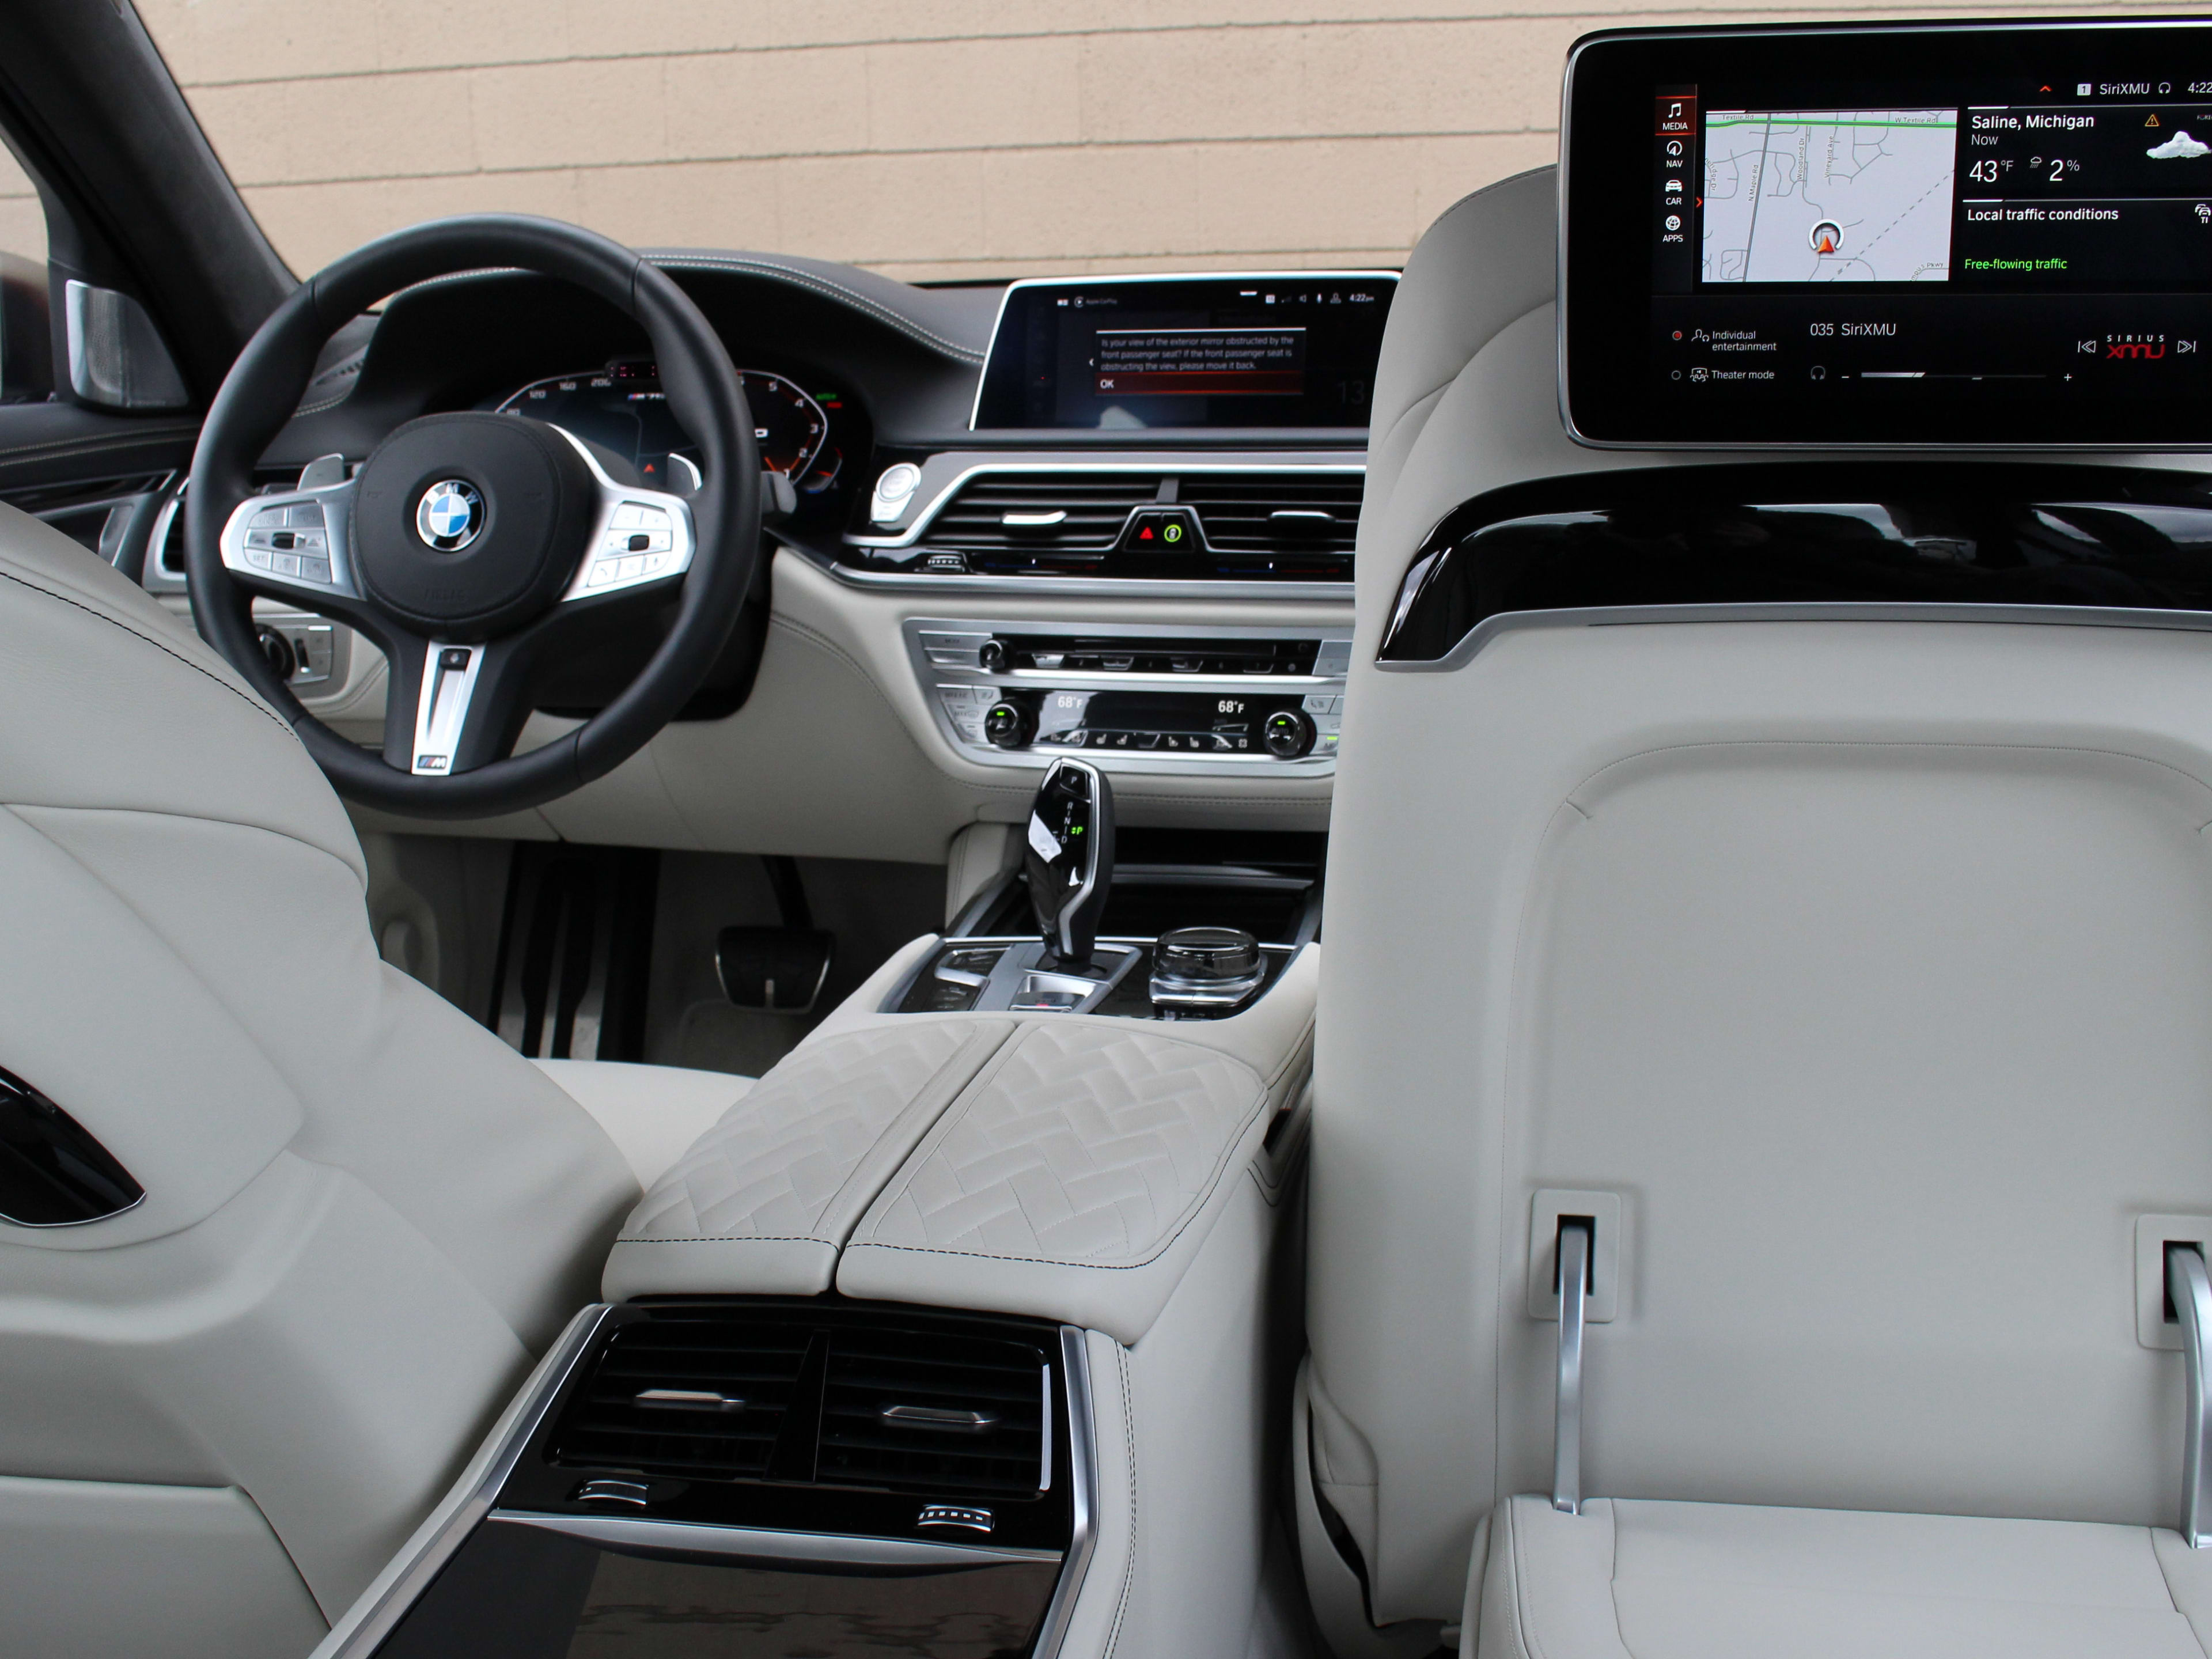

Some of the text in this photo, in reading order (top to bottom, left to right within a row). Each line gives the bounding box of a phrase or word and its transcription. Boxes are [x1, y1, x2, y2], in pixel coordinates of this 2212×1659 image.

[2099, 83, 2150, 95] SiriXMU
[1662, 122, 1688, 131] MEDIA
[1971, 115, 2094, 130] Saline, Michigan
[1798, 137, 1805, 146] Dr
[1971, 134, 1998, 145] Now
[1666, 160, 1683, 168] NAV
[1752, 164, 1759, 174] Rd
[1824, 150, 1832, 178] Vineyard
[1665, 197, 1682, 206] CAR
[1968, 208, 2119, 221] Local traffic conditions
[1662, 234, 1684, 243] APPS
[1964, 258, 2067, 271] Free-flowing traffic
[1810, 323, 1896, 336] 035 SiriXMU
[1713, 331, 1756, 340] Individual
[2107, 335, 2165, 343] SIRIUS
[1110, 340, 1127, 349] your
[1146, 338, 1154, 346] of
[1156, 338, 1169, 346] the
[1169, 338, 1199, 346] exterior
[1225, 336, 1268, 345] obstructed
[1269, 336, 1279, 346] by
[1281, 336, 1294, 345] the
[1712, 342, 1777, 351] entertainment
[1101, 350, 1120, 358] front
[1120, 351, 1160, 360] passenger
[1190, 350, 1203, 358] the
[1205, 350, 1224, 358] front
[1225, 350, 1266, 359] passenger
[1267, 349, 1283, 358] seat
[1285, 349, 1293, 357] is
[1101, 363, 1144, 372] obstructing
[1145, 363, 1158, 372] the
[1179, 362, 1205, 372] please
[1711, 370, 1774, 380] Theater mode
[768, 381, 778, 392] 5
[1100, 379, 1114, 389] OK
[810, 423, 819, 434] 3
[426, 483, 480, 505] BMW
[1067, 802, 1073, 810] R
[1064, 817, 1071, 825] N
[1076, 826, 1084, 835] P
[1061, 836, 1067, 844] D
